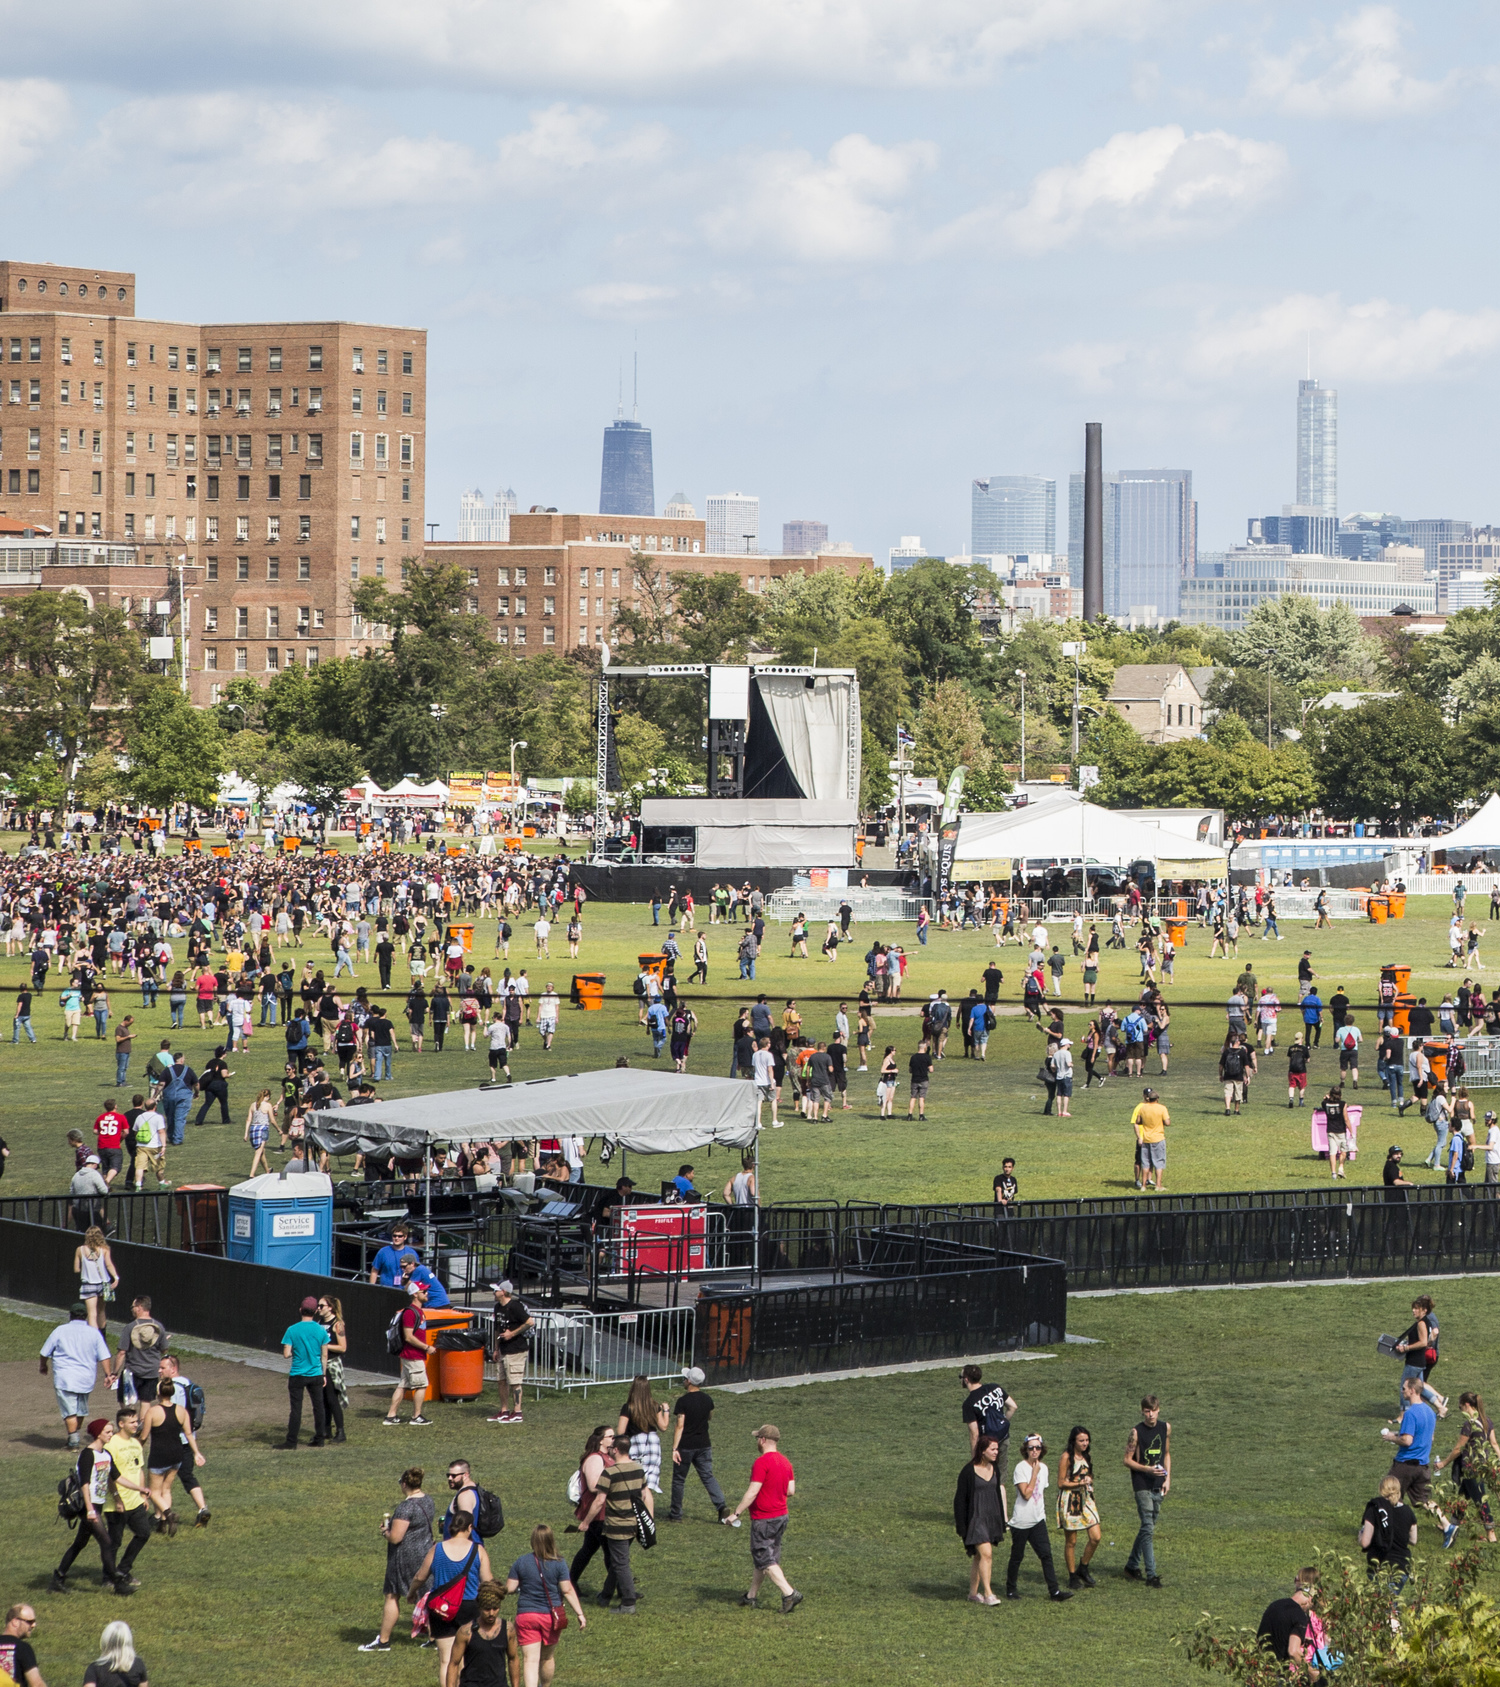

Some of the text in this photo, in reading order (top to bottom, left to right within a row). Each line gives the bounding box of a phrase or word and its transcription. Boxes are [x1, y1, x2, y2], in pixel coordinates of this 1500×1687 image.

[941, 776, 961, 823] ATM
[941, 843, 953, 876] EQUIS
[99, 1119, 119, 1136] 56
[278, 1215, 310, 1225] Service
[973, 1387, 1004, 1411] YOUR
[640, 1510, 655, 1536] URBAN
